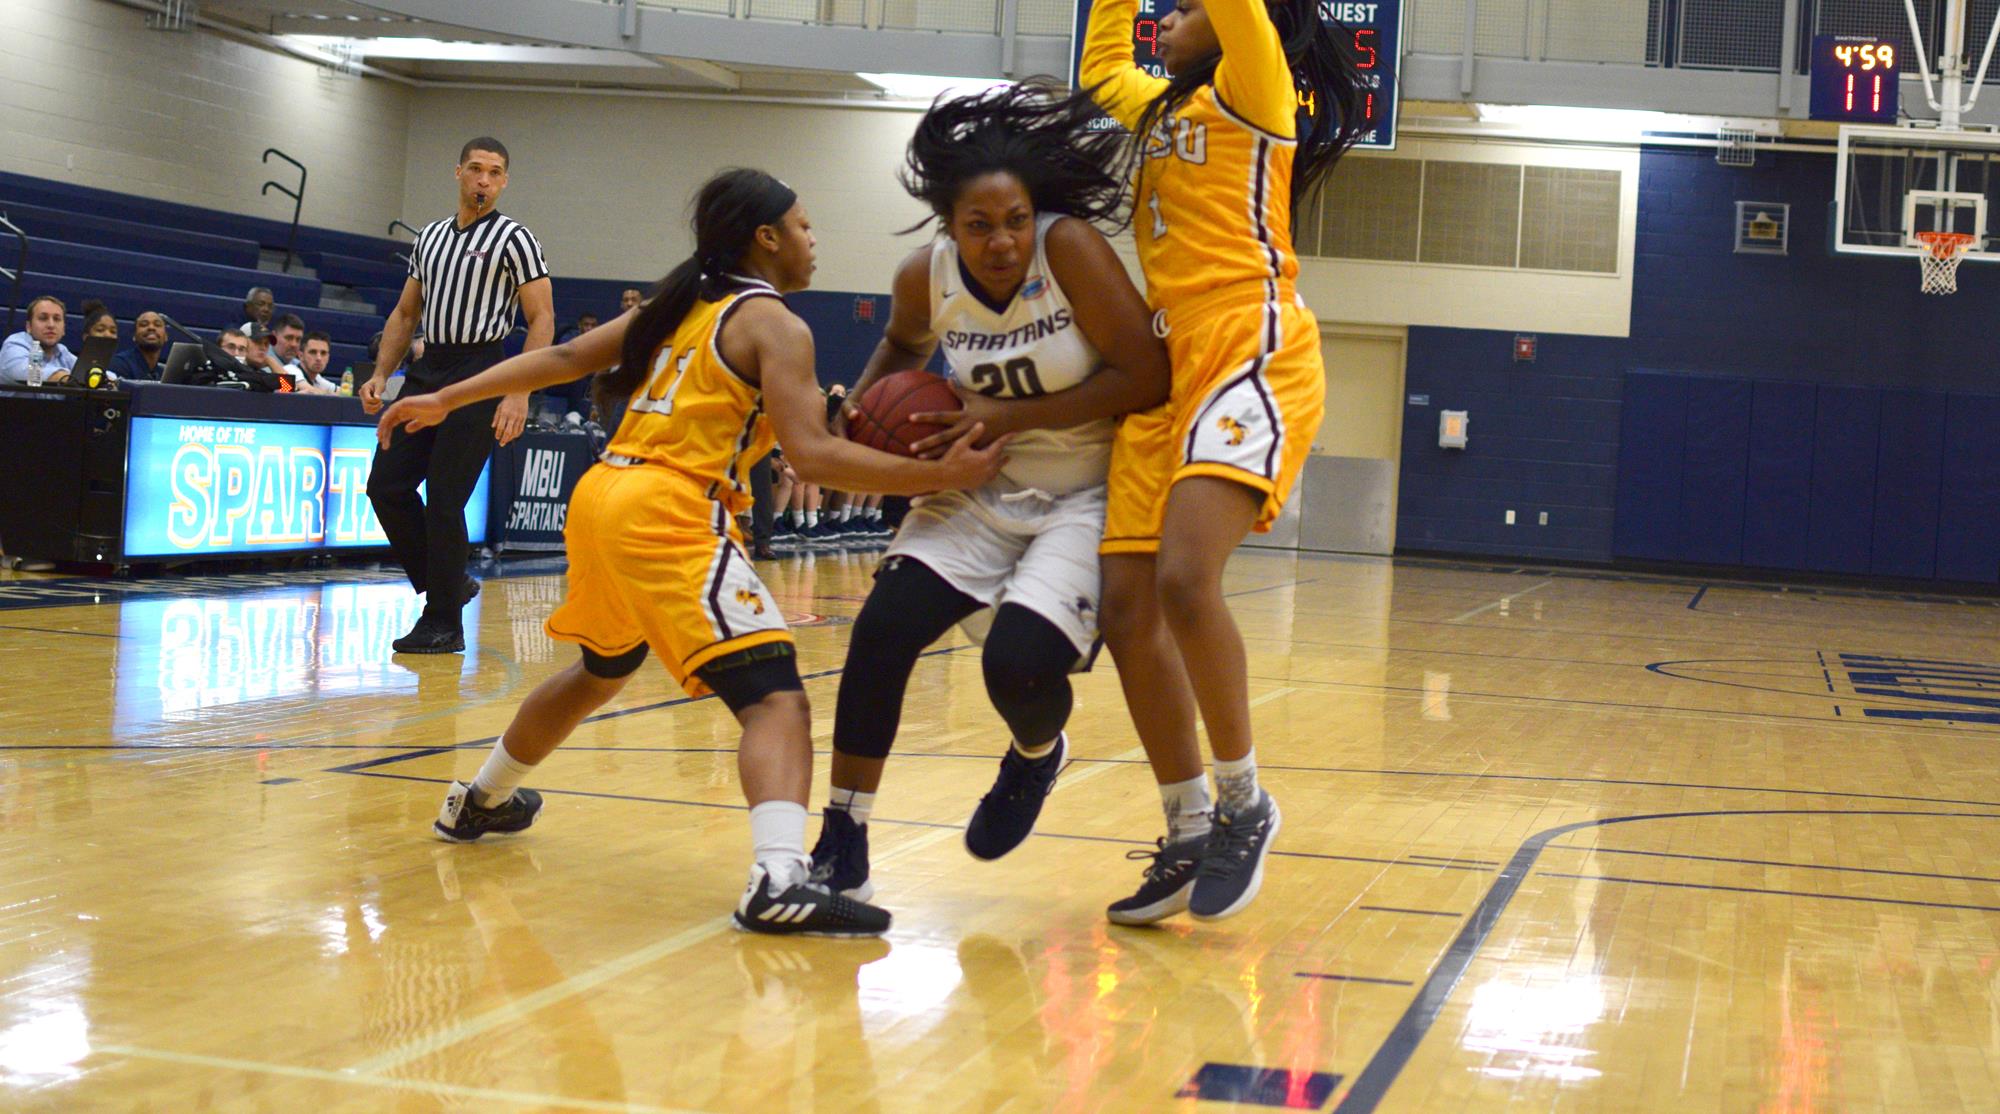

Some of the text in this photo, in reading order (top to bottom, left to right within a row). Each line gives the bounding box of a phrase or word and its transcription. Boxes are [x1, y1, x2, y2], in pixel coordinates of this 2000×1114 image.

[1317, 2, 1378, 23] GUEST
[1846, 74, 1881, 112] 11
[946, 308, 1071, 350] SPARTANS
[630, 345, 697, 416] 11
[971, 357, 1046, 399] 20
[179, 425, 256, 444] HOME OF THE
[520, 448, 566, 497] MBU
[167, 442, 390, 548] SPART
[505, 501, 567, 531] SPARTANS
